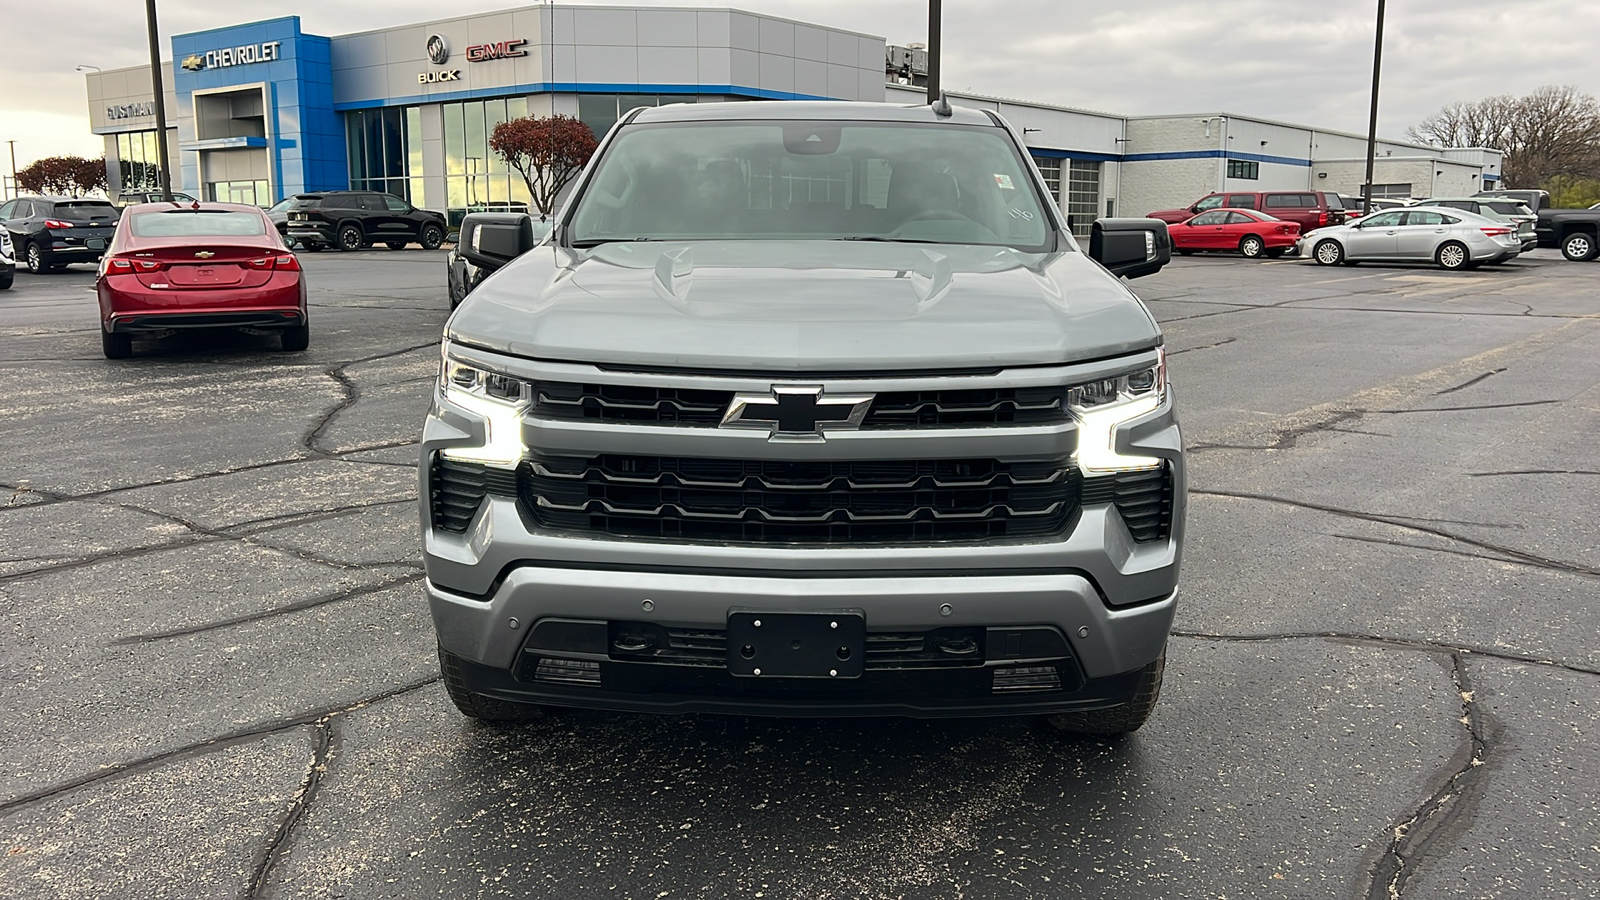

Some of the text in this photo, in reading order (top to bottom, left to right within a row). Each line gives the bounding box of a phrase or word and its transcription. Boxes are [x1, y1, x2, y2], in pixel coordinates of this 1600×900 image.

[206, 41, 279, 69] CHEVROLET
[466, 39, 526, 62] GMC
[417, 69, 459, 84] BUICK
